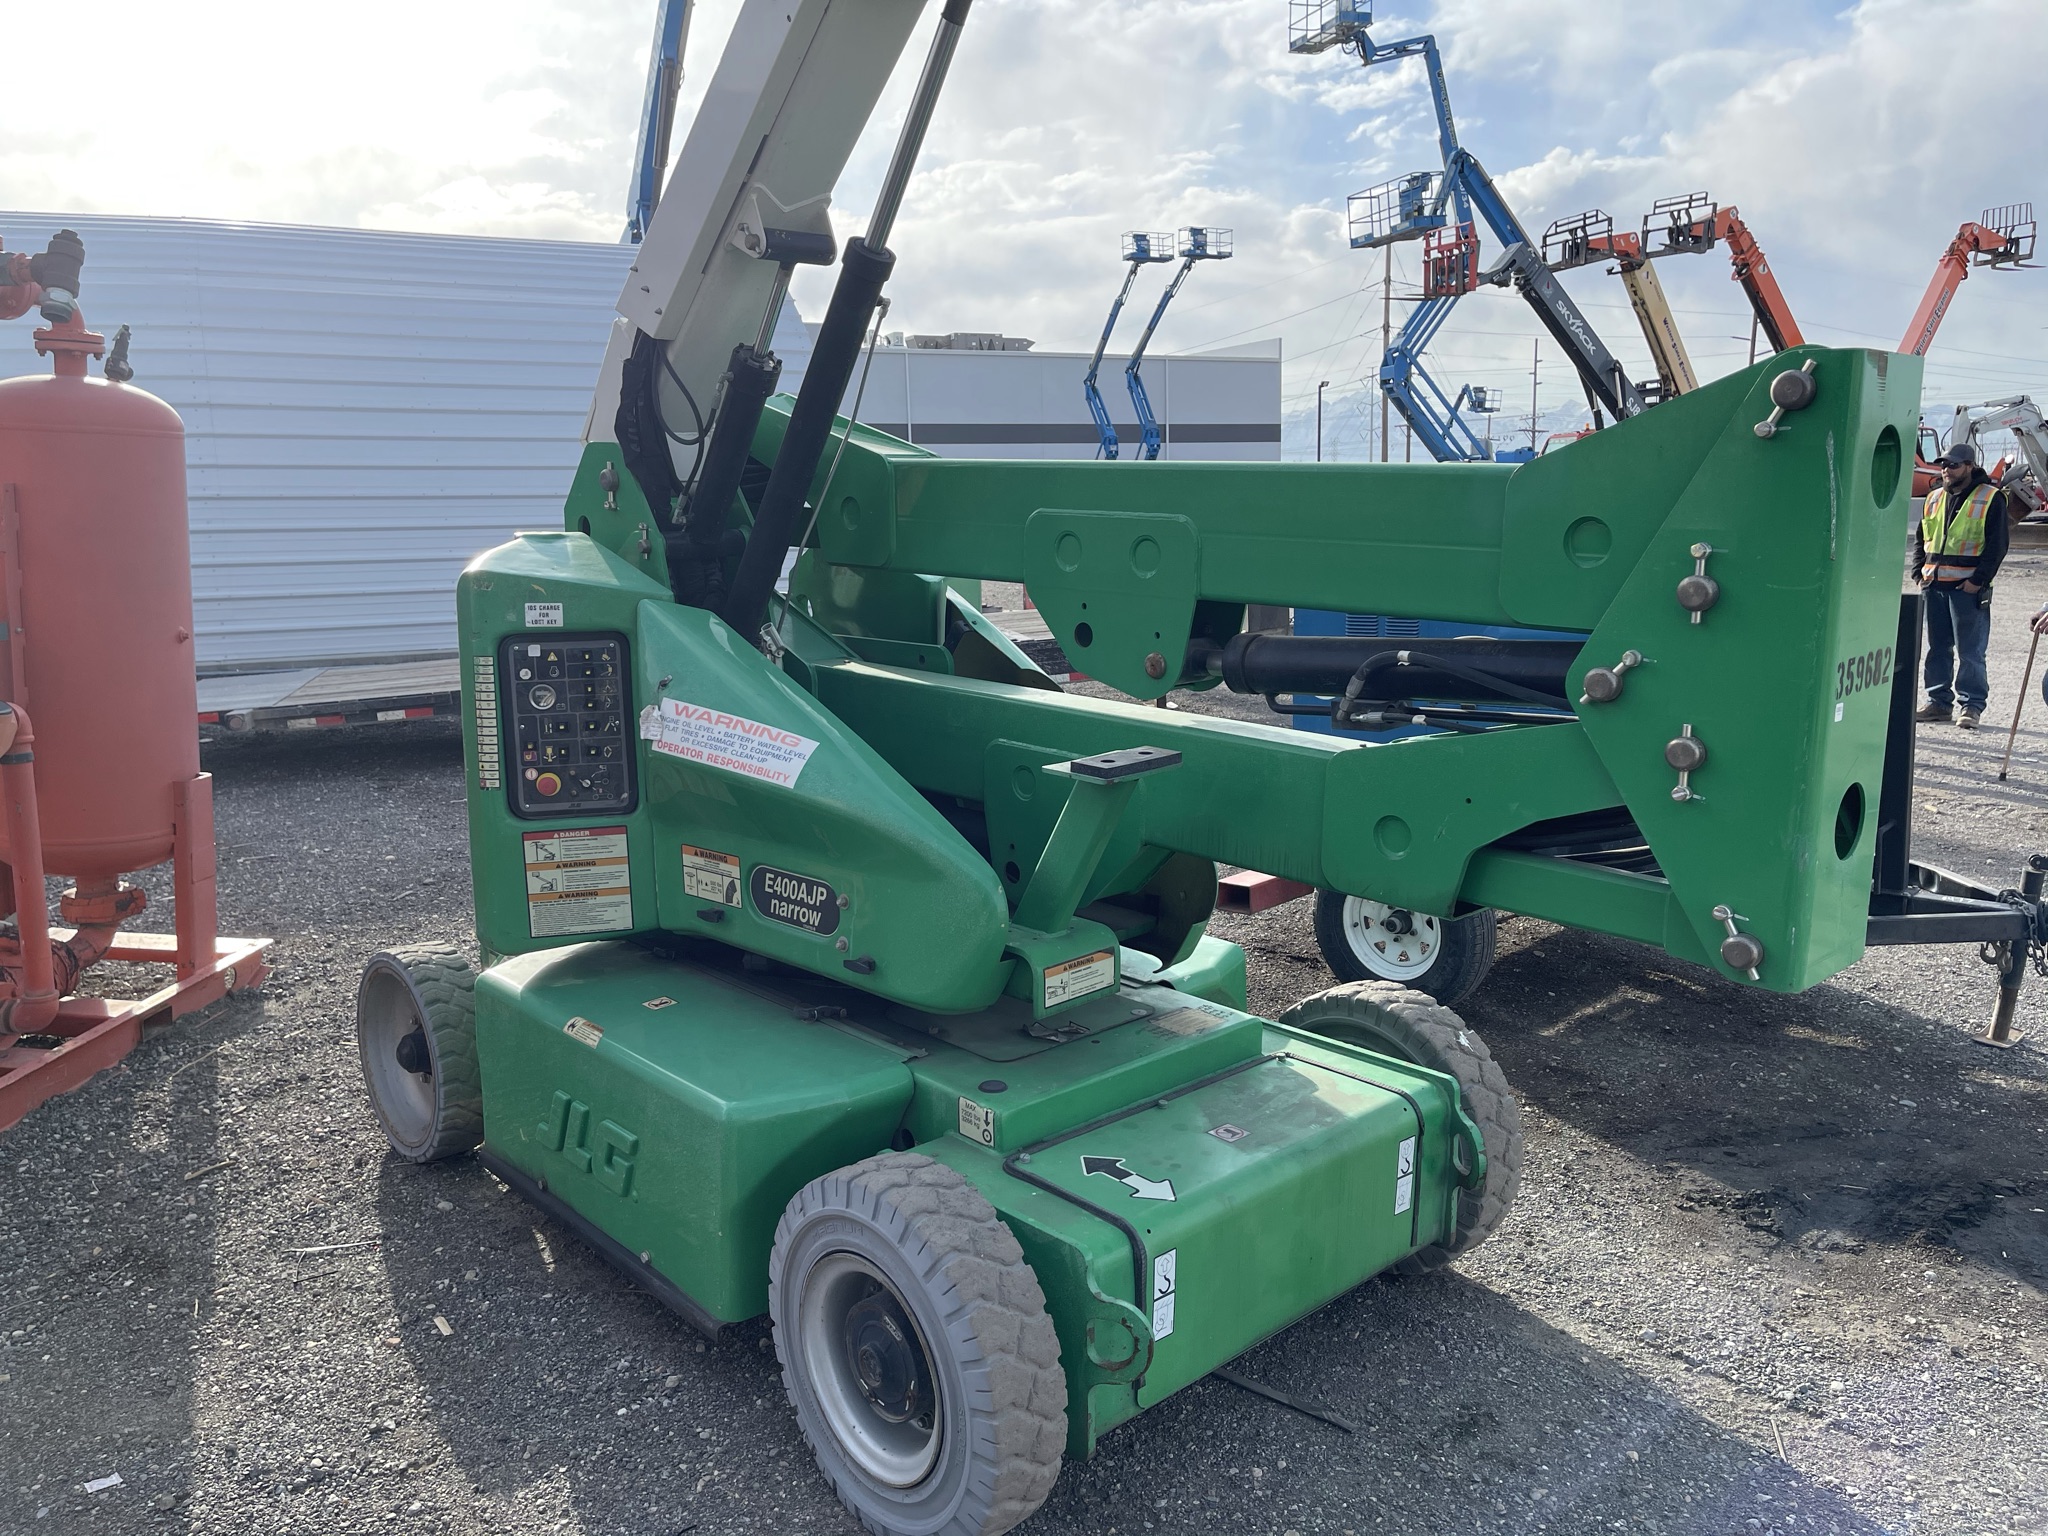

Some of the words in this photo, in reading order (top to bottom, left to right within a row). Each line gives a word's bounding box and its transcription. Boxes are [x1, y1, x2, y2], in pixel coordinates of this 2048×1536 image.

[1555, 299, 1597, 356] SKYJACK
[674, 703, 802, 748] WARNING
[682, 720, 692, 728] OIL
[694, 723, 715, 735] LEVEL
[723, 731, 755, 745] BATTERY
[757, 741, 782, 753] WATER
[784, 748, 807, 761] LEVEL
[664, 724, 680, 735] FLAT
[681, 729, 699, 739] TIRES
[706, 735, 736, 748] DAMAGE
[738, 742, 749, 750] TO
[750, 746, 794, 763] EQUIPMENT
[692, 739, 728, 754] EXCESSIVE
[730, 749, 768, 764] CLEAN-UP
[657, 740, 704, 760] OPERATOR
[706, 753, 791, 783] RESPONSIBILITY
[560, 830, 590, 838] DANGER
[562, 861, 597, 869] WARNING
[699, 850, 728, 863] WARNING
[565, 891, 599, 899] WARNING
[764, 872, 828, 907] E400AJP
[770, 898, 822, 926] narrow
[1068, 956, 1095, 970] WARNING
[536, 1089, 639, 1197] JLG
